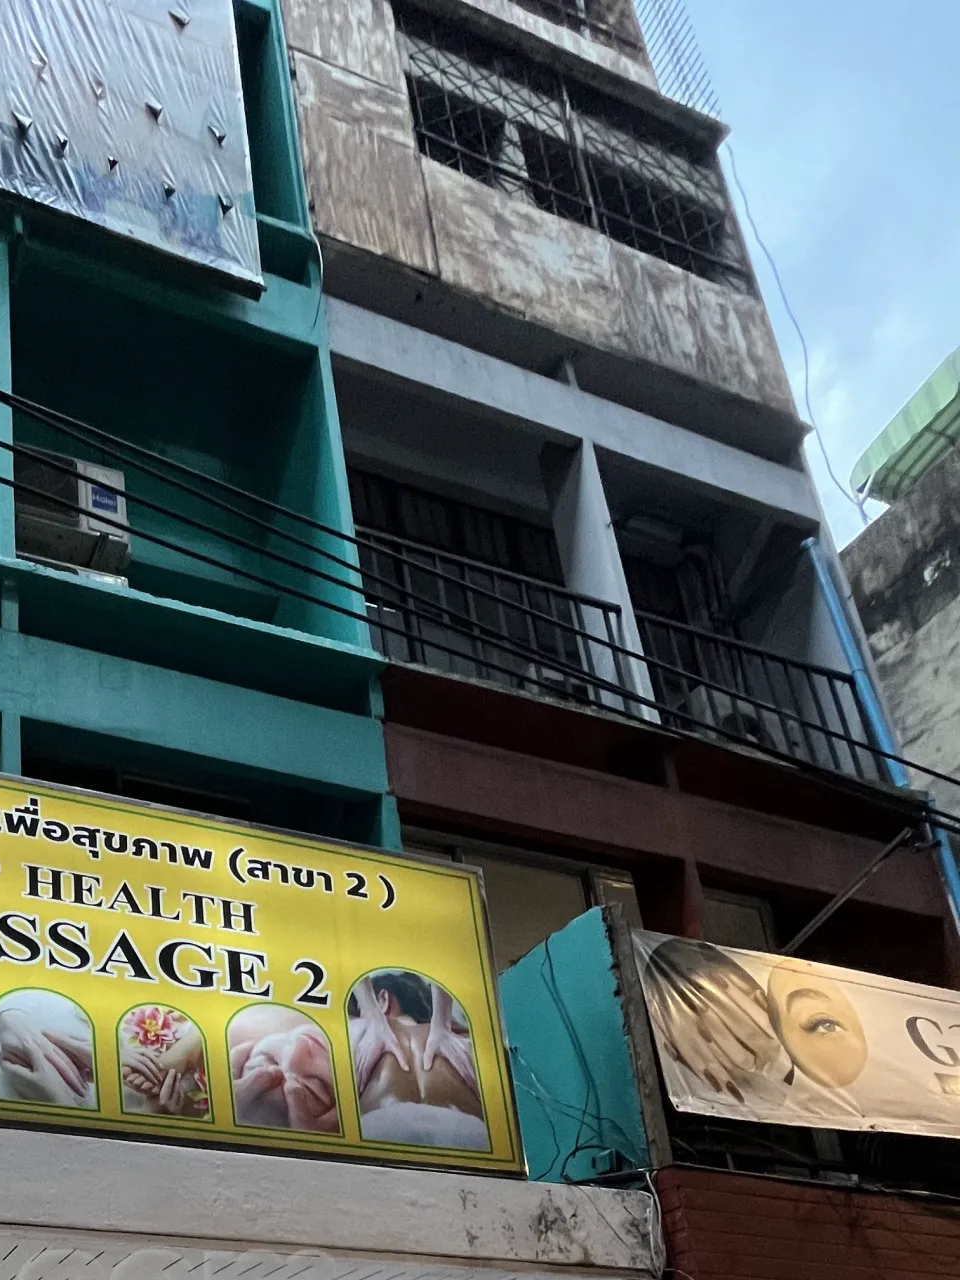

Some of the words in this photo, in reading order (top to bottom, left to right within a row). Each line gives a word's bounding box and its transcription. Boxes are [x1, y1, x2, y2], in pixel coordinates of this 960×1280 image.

[227, 847, 334, 897] (สาขา
[25, 863, 258, 937] HEALTH
[292, 961, 332, 1008] 2
